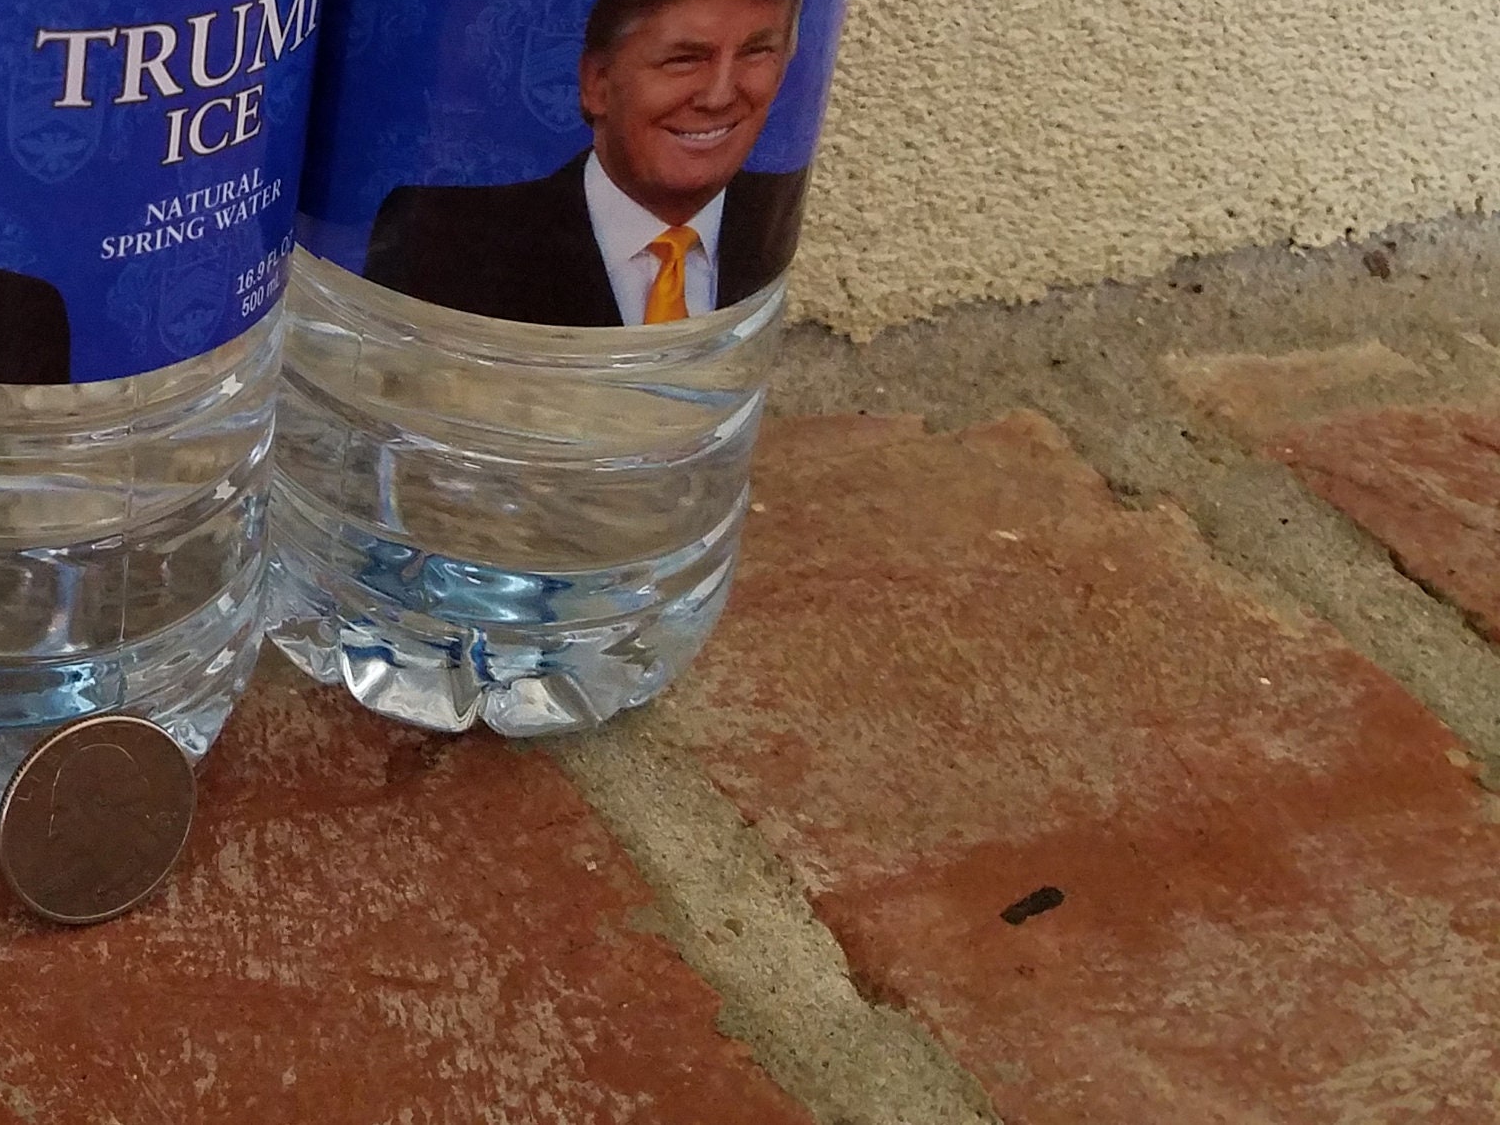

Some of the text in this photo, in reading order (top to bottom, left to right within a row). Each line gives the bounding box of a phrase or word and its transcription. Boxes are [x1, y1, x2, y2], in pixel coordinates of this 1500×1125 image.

[161, 84, 263, 165] ICE
[100, 178, 282, 260] SPRING WATER
[144, 168, 263, 226] NATURAL
[236, 261, 265, 294] 16.9
[266, 248, 278, 273] FL
[242, 286, 265, 317] 500
